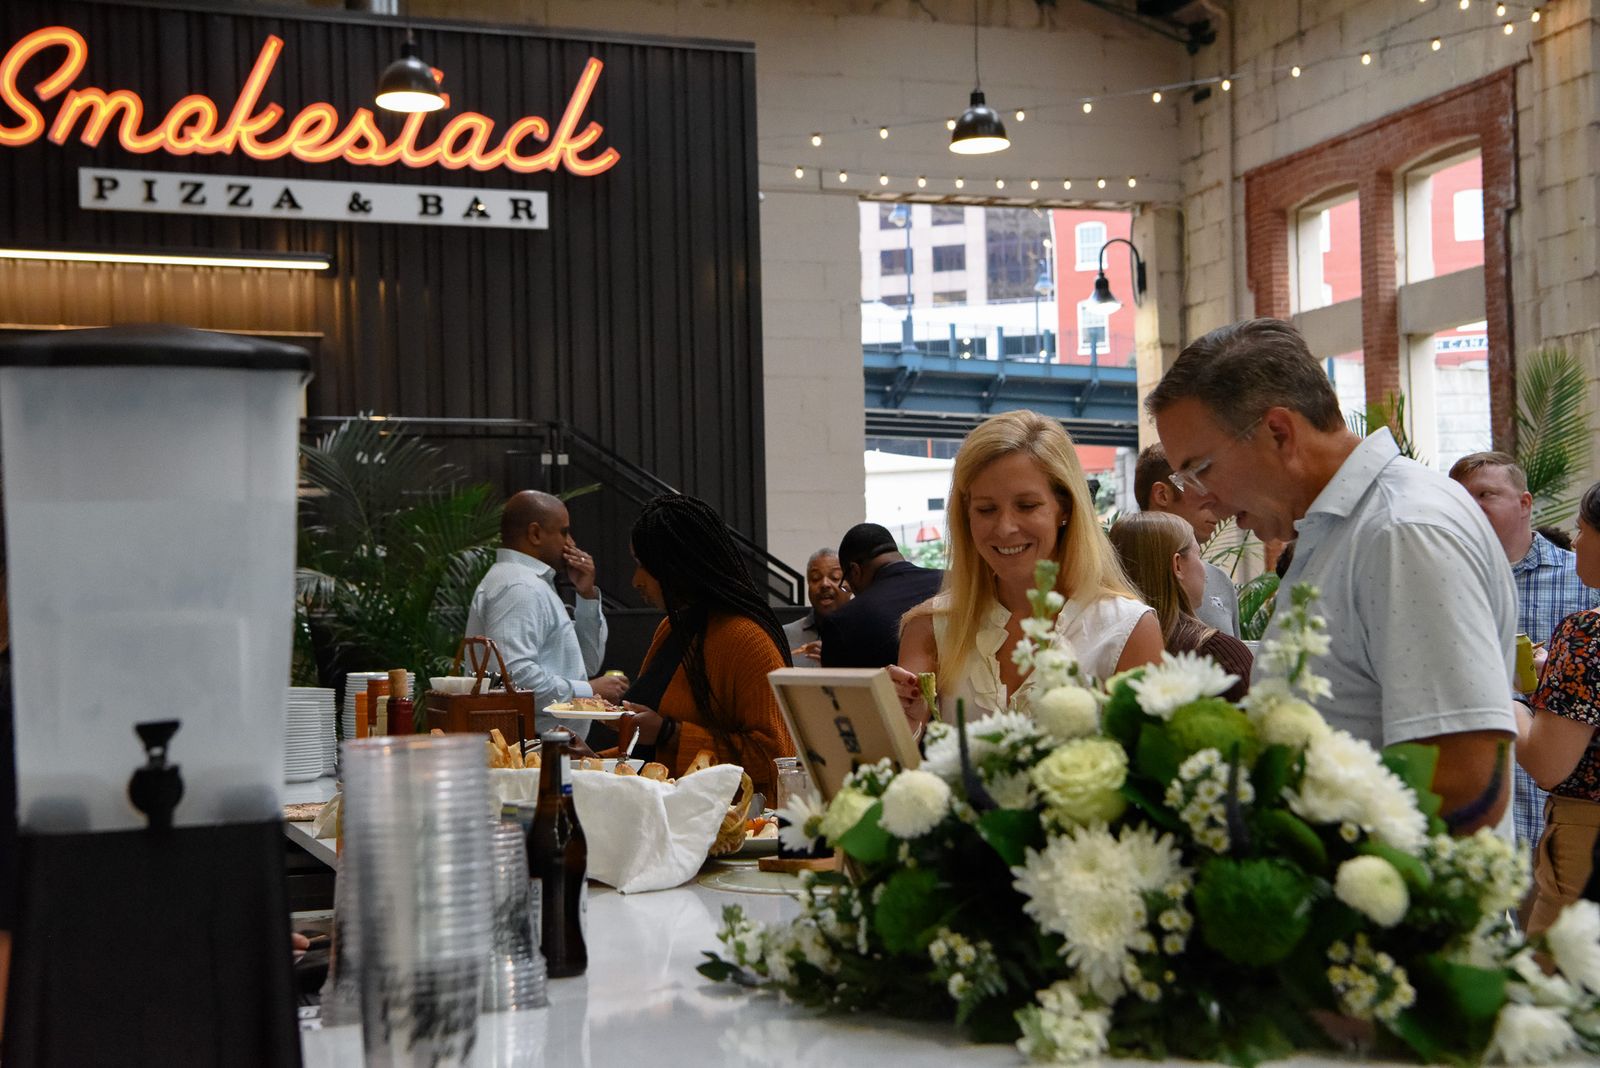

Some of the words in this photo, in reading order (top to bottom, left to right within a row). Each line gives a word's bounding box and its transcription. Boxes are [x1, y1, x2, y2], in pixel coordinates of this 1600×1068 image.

[94, 176, 302, 211] PIZZA
[348, 192, 372, 213] &
[418, 193, 536, 221] BAR
